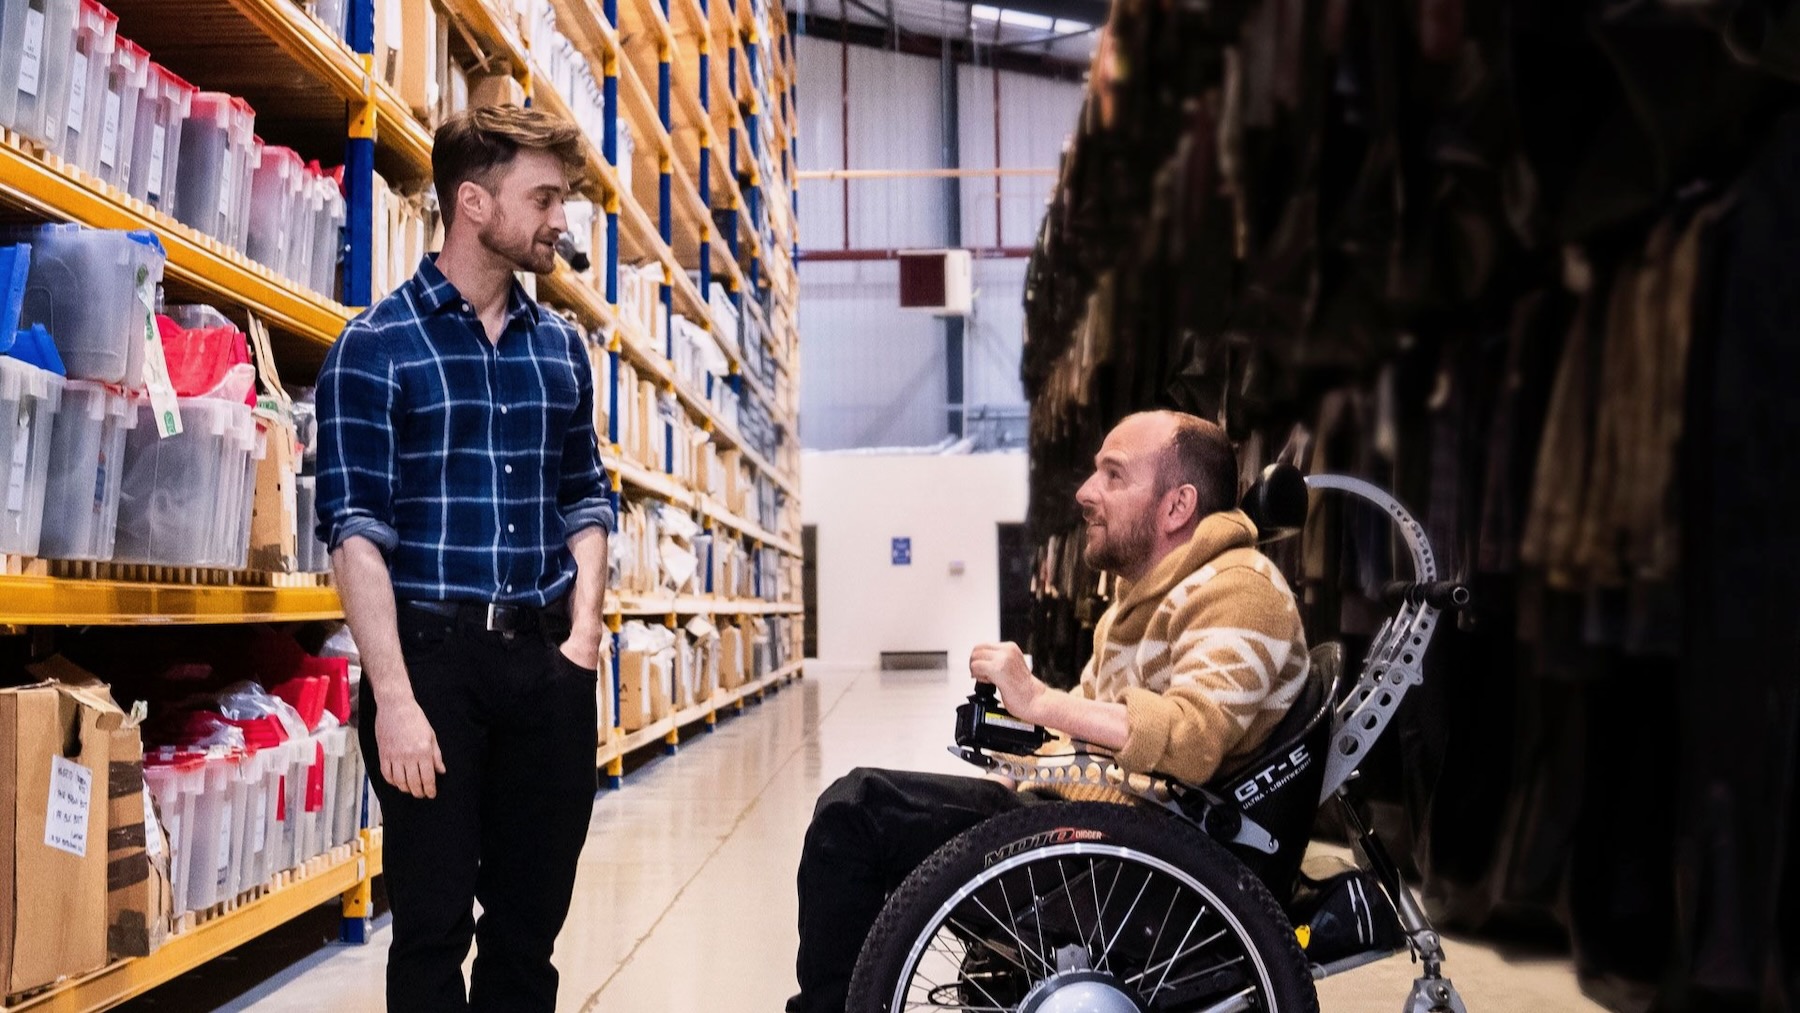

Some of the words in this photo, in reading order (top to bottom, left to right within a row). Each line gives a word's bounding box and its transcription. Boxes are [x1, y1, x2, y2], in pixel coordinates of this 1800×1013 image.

[1234, 744, 1309, 802] GT-E
[1242, 793, 1265, 810] ULTRA
[1269, 757, 1312, 793] LIGHTWEIGHT
[984, 827, 1075, 870] MOTO
[1075, 829, 1102, 841] DIGGER
